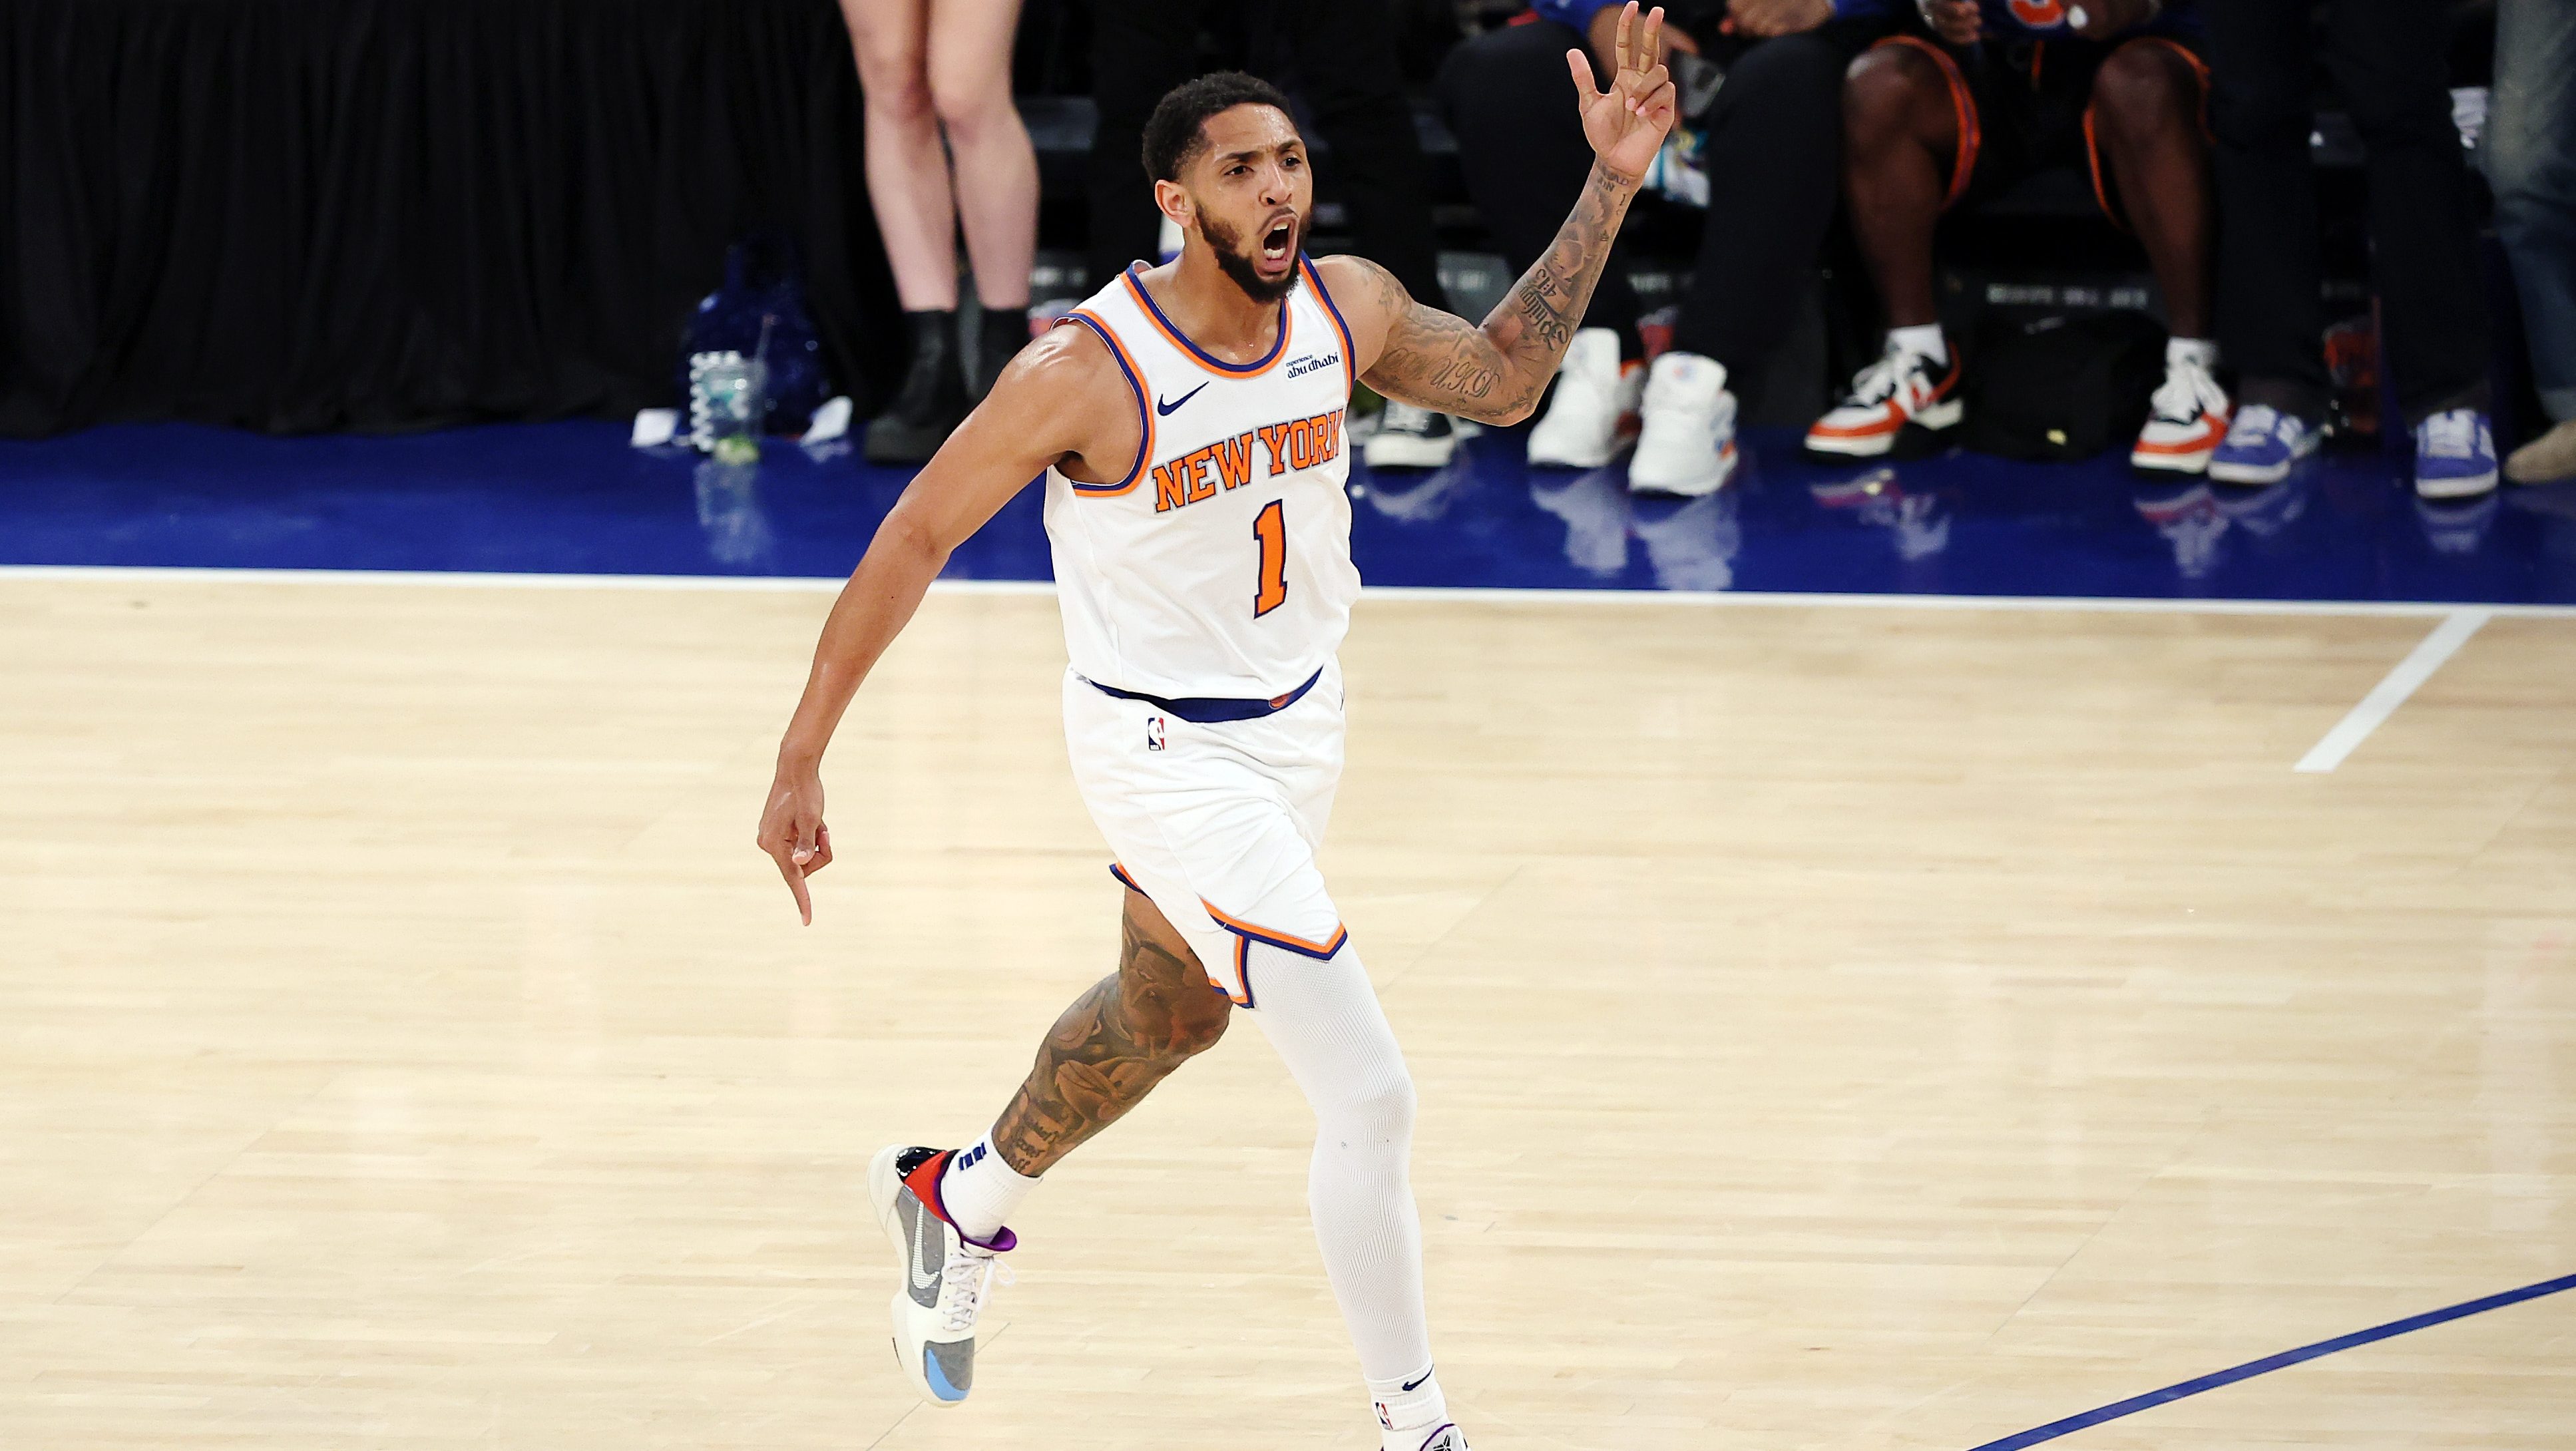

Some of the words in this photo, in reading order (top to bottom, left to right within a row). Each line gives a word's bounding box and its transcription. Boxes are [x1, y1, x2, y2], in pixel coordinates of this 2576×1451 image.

[1287, 365, 1308, 379] abu
[1308, 351, 1339, 371] dhabi
[1151, 430, 1254, 513] NEW
[1257, 407, 1343, 477] YORK
[1253, 498, 1288, 619] 1
